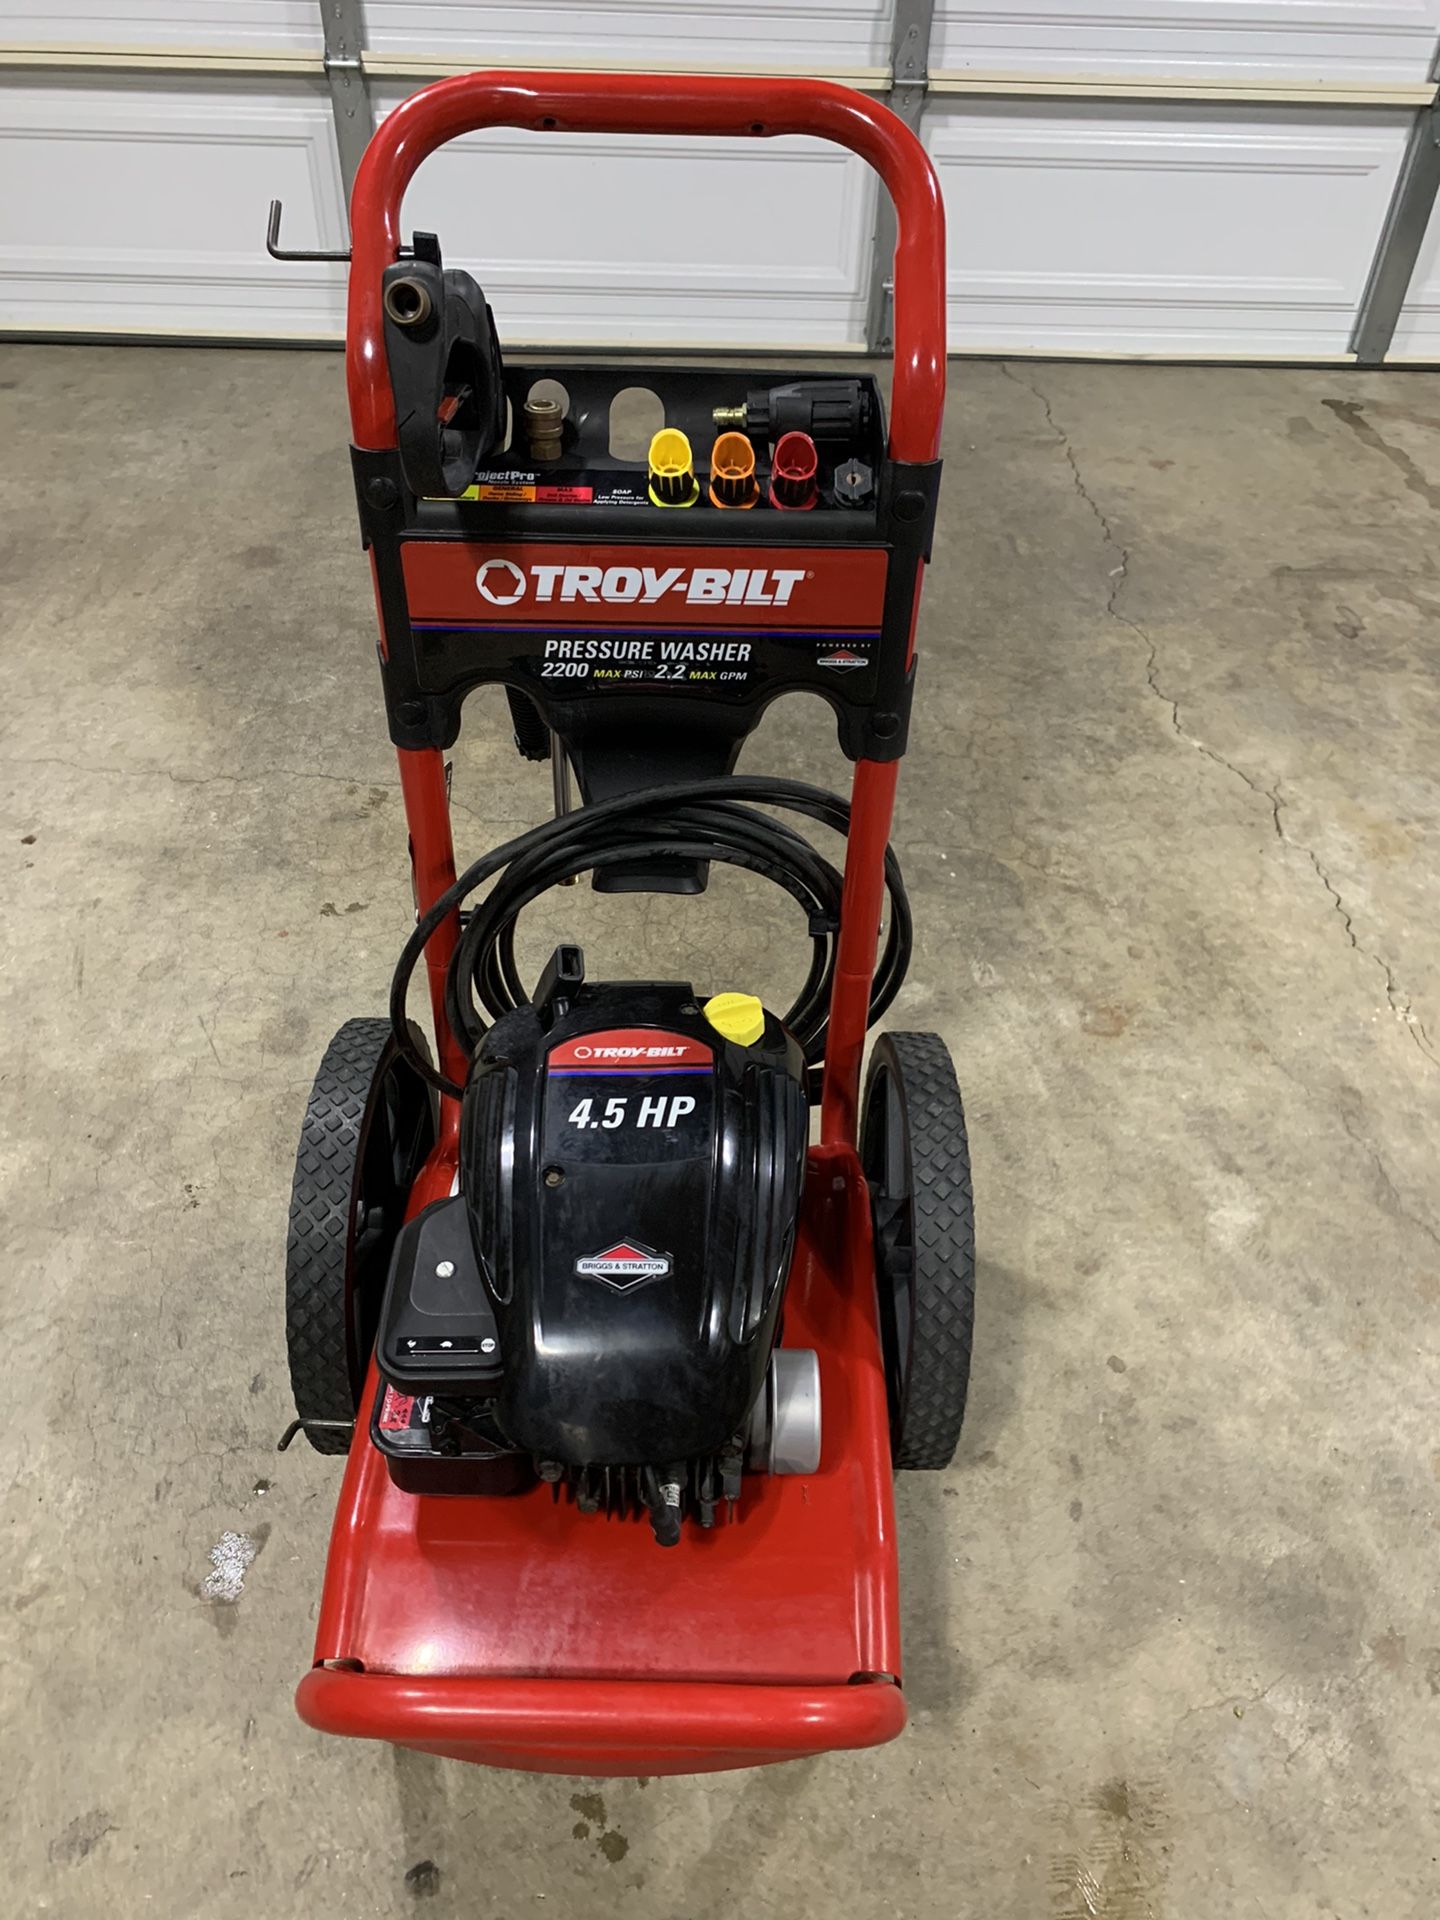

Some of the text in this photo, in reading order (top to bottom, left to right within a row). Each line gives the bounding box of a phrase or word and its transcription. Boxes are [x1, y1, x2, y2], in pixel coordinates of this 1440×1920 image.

[475, 471, 535, 481] ojectPro
[530, 565, 806, 606] TROY-BILT
[544, 640, 752, 662] PRESSURE WASHER
[540, 662, 748, 681] 2200 MAX PSI 2.2 MAX GPM
[592, 1046, 688, 1058] TROY-BILT
[568, 1096, 696, 1129] 4.5 HP
[582, 1262, 664, 1270] BRIGGS & STRATTON
